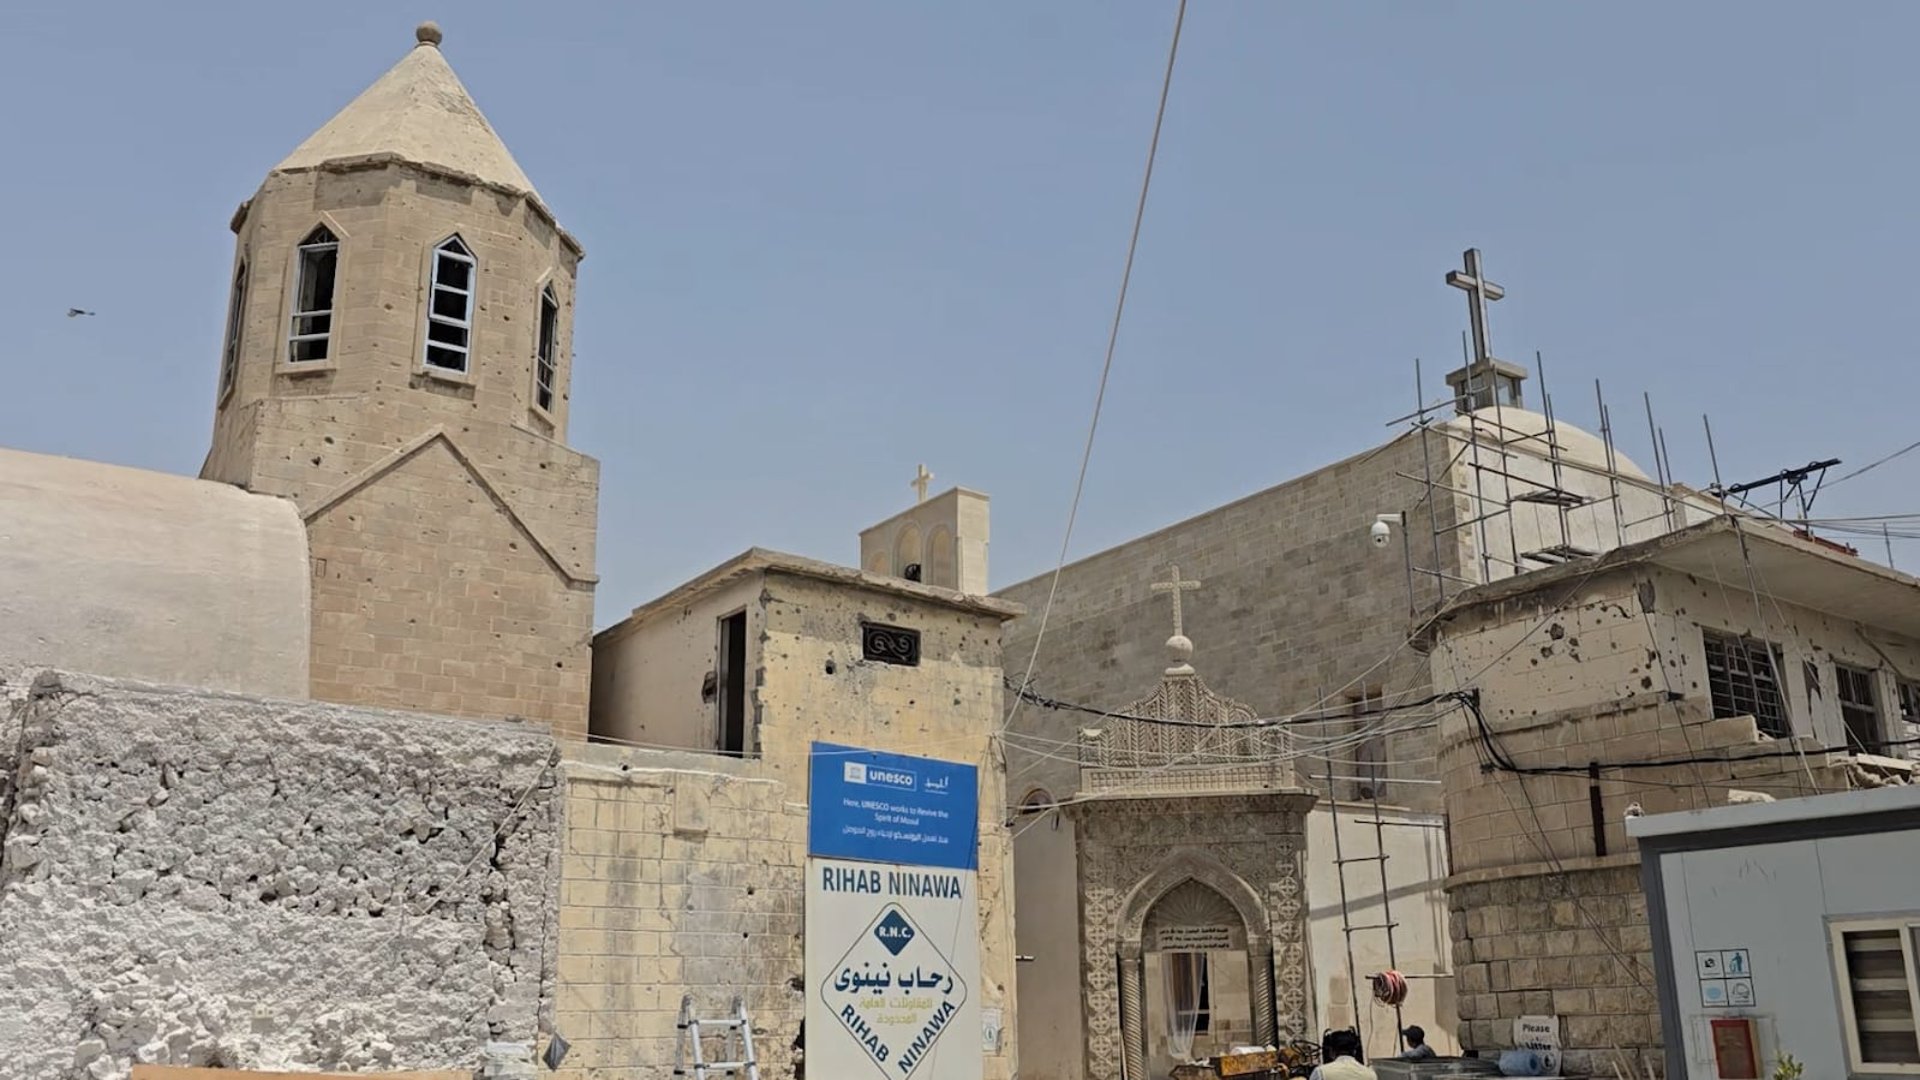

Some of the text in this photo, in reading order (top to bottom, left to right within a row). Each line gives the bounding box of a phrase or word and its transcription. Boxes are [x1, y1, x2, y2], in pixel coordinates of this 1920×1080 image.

[869, 770, 913, 786] unesco
[861, 800, 889, 811] UNESCO
[890, 805, 908, 814] works
[909, 807, 916, 815] to
[917, 807, 937, 817] Revive
[937, 809, 949, 818] the
[874, 813, 919, 825] Spirit of Mosul
[822, 867, 962, 899] RIHAB NINAWA
[879, 926, 911, 938] R.N.C.
[834, 962, 954, 995] رحاب نينوى
[841, 1004, 890, 1063] RIHAB
[897, 1000, 955, 1074] NINAWA
[1522, 1023, 1551, 1033] Please
